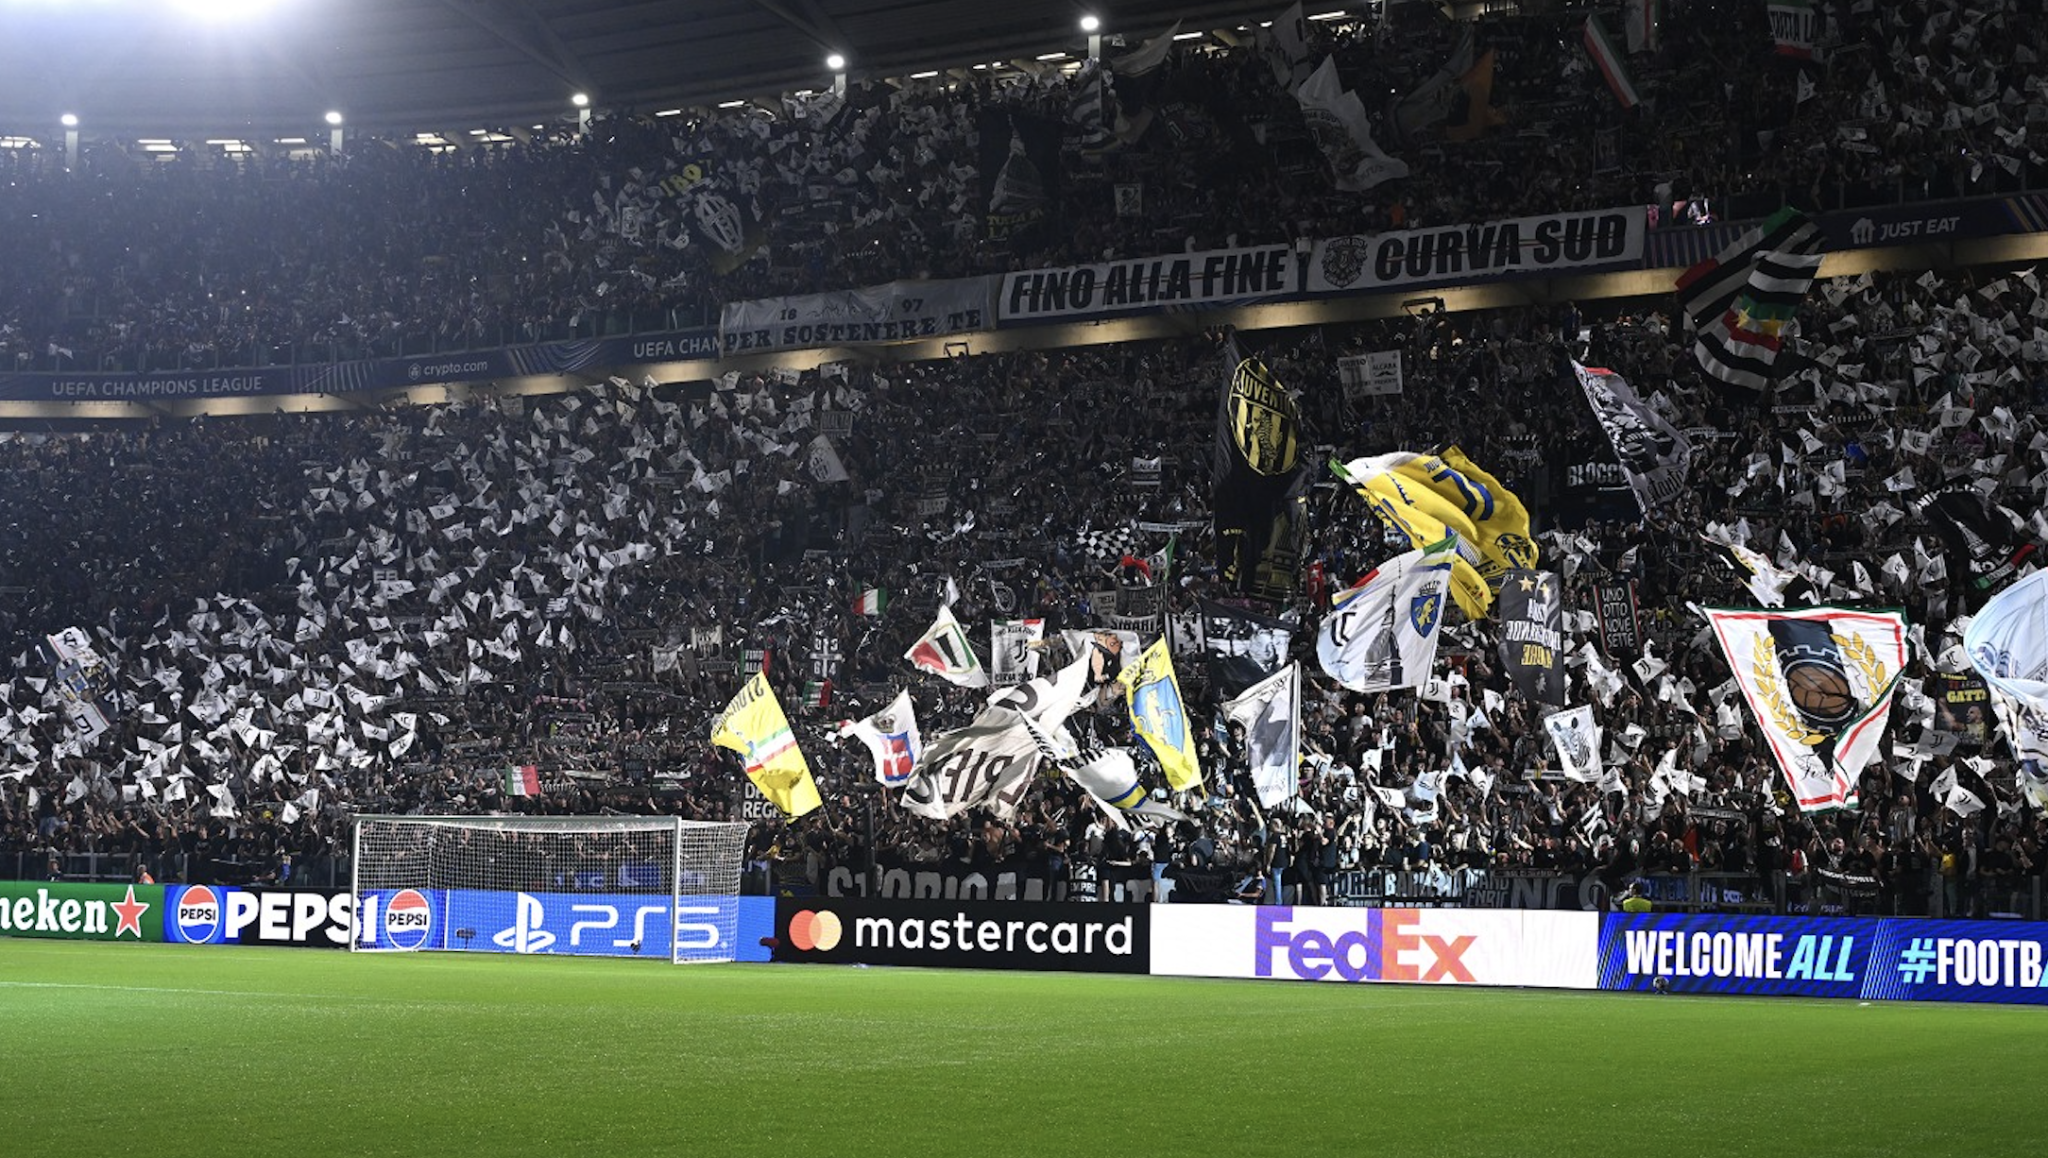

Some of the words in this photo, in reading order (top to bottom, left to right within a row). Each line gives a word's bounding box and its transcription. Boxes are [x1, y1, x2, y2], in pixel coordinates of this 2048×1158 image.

[1880, 220, 1922, 241] JUST
[1926, 216, 1960, 235] EAT
[1375, 223, 1521, 281] CURVA
[1533, 213, 1627, 264] SUD
[1009, 268, 1096, 314] FINO
[1103, 259, 1191, 305] ALLA
[1202, 249, 1289, 297] FINE
[780, 308, 797, 320] 18
[902, 298, 923, 313] 97
[724, 329, 772, 351] PER
[783, 317, 936, 345] SOSTENERE
[947, 309, 981, 331] TE
[634, 337, 675, 359] UEFA
[422, 361, 488, 377] crypto.com
[52, 381, 97, 396] UEFA
[102, 379, 197, 395] CHAMPIONS
[203, 376, 262, 393] LEAGUE
[1567, 461, 1625, 487] BLOCC
[1601, 586, 1625, 602] UNO
[1602, 602, 1628, 618] OTTO
[1605, 616, 1632, 632] NOVE
[1606, 632, 1635, 648] SETTE
[180, 908, 216, 921] PEPSI
[225, 891, 378, 944] PEPSI
[387, 912, 428, 926] PEPSI
[570, 904, 722, 949] PS5
[855, 910, 1133, 957] mastercard
[1254, 906, 1477, 983] FedEx
[1625, 930, 1784, 979] WELCOME
[1785, 934, 1855, 982] ALL
[1897, 936, 2048, 988] #FOOTB
